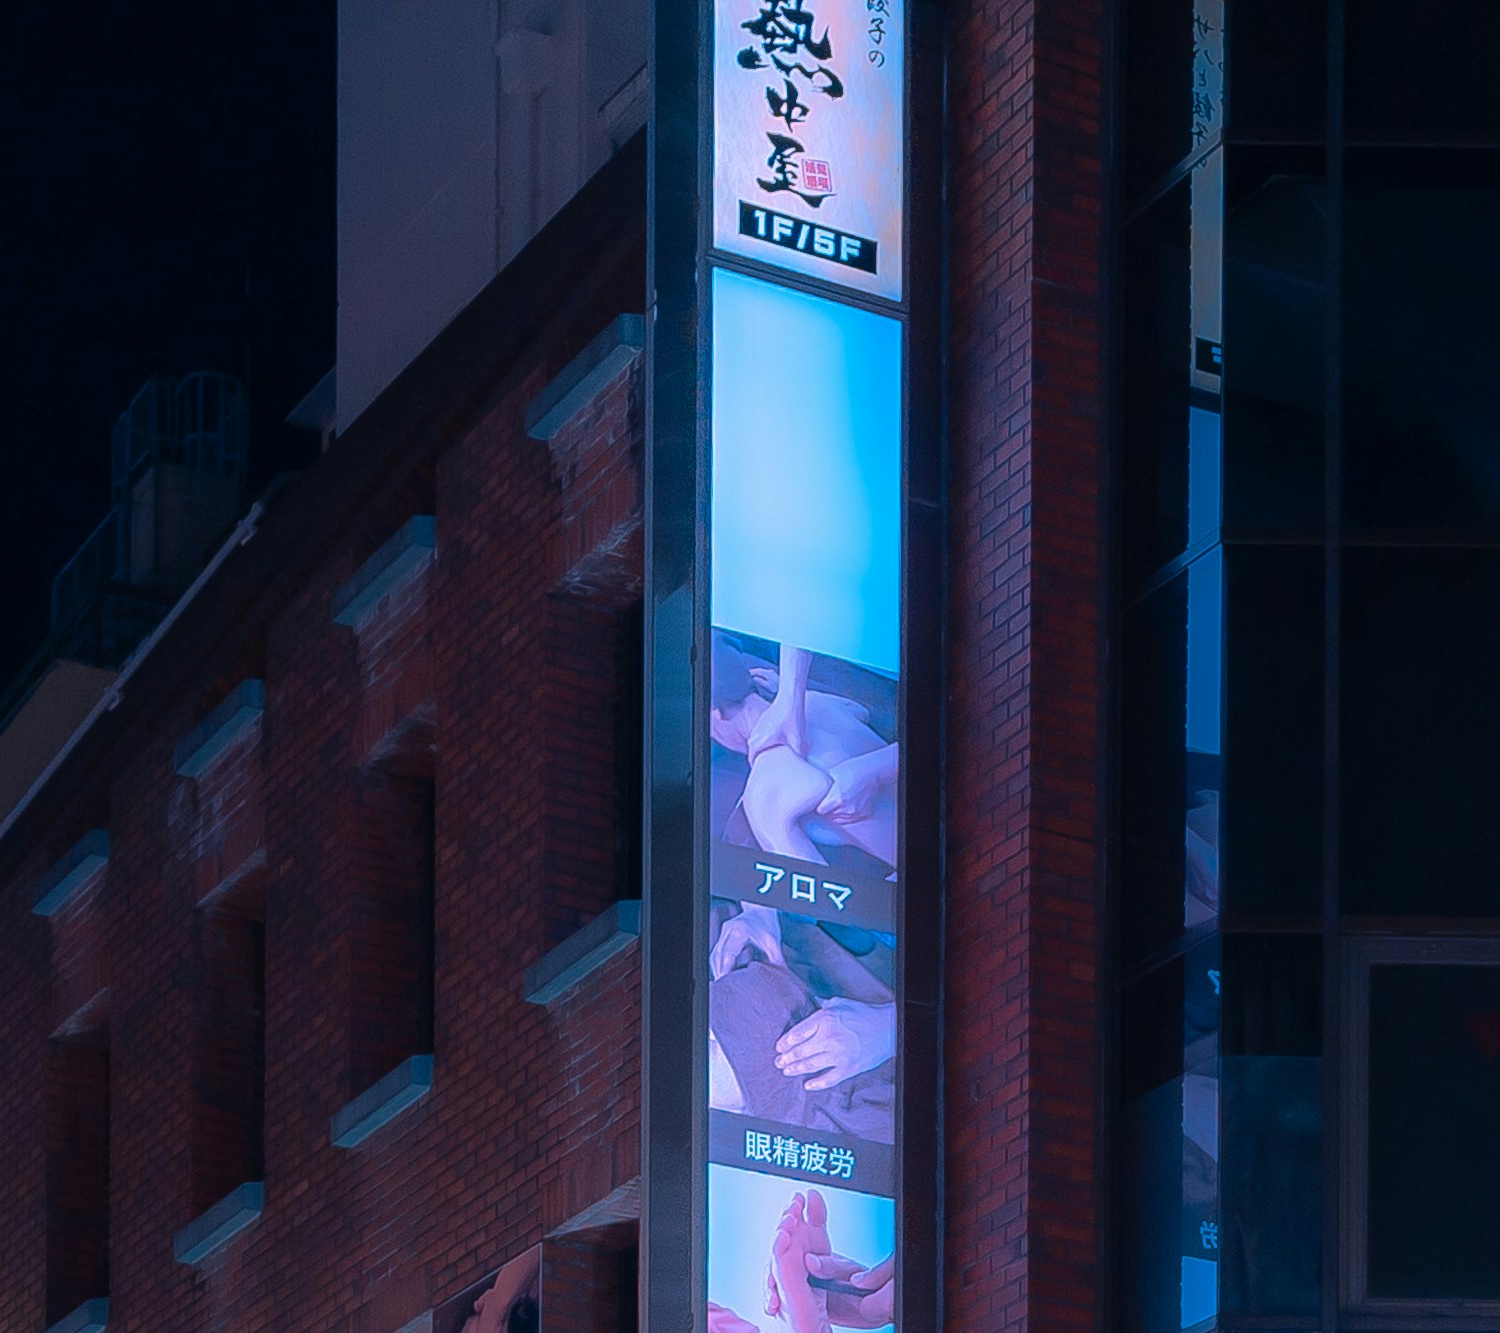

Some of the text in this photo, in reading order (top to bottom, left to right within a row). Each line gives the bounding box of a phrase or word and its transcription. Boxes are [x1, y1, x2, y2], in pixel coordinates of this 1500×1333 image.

[753, 209, 862, 262] 1F/5F
[753, 862, 854, 912] アロマ
[744, 1128, 855, 1181] 眼精疲労
